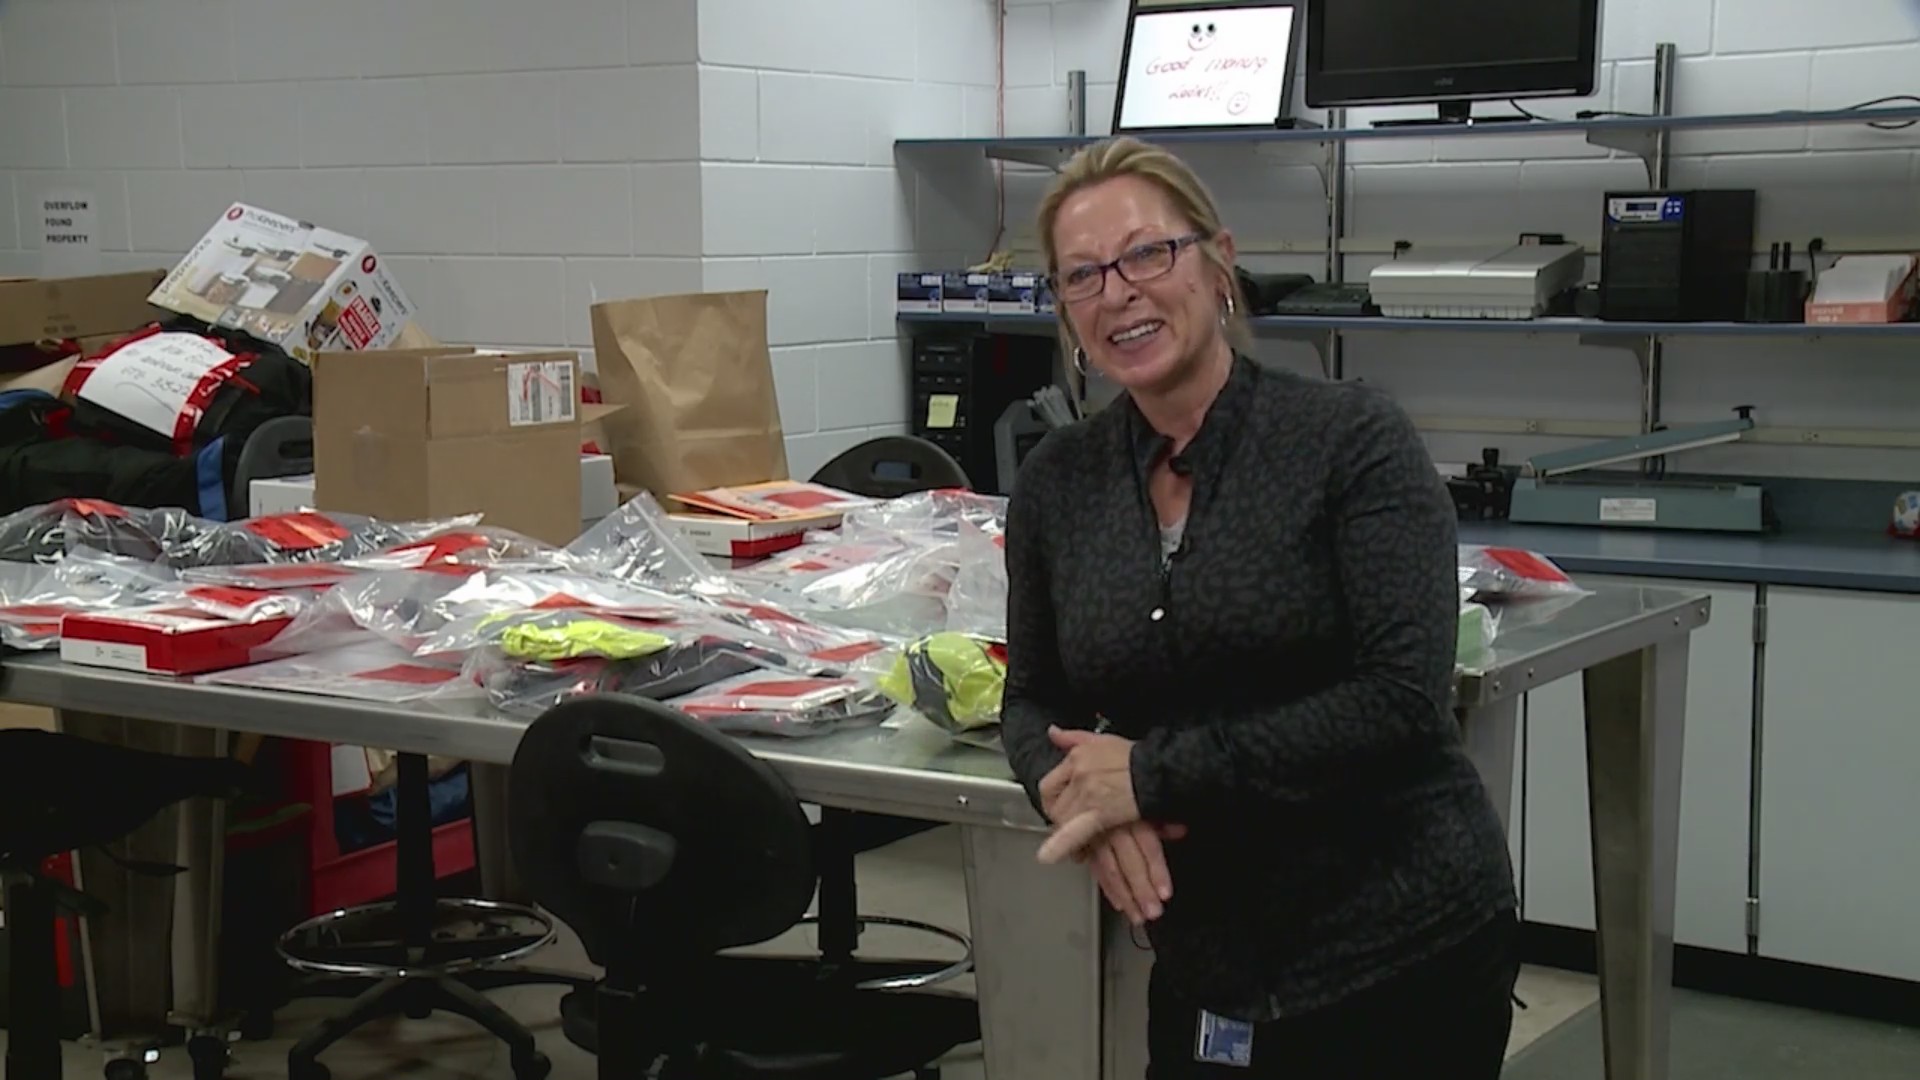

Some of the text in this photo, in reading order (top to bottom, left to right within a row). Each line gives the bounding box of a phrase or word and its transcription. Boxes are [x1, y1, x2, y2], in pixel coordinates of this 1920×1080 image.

[1145, 57, 1193, 75] Good
[44, 200, 88, 210] OVERFLOW
[45, 217, 72, 227] FOUND
[46, 234, 88, 243] PROPERTY
